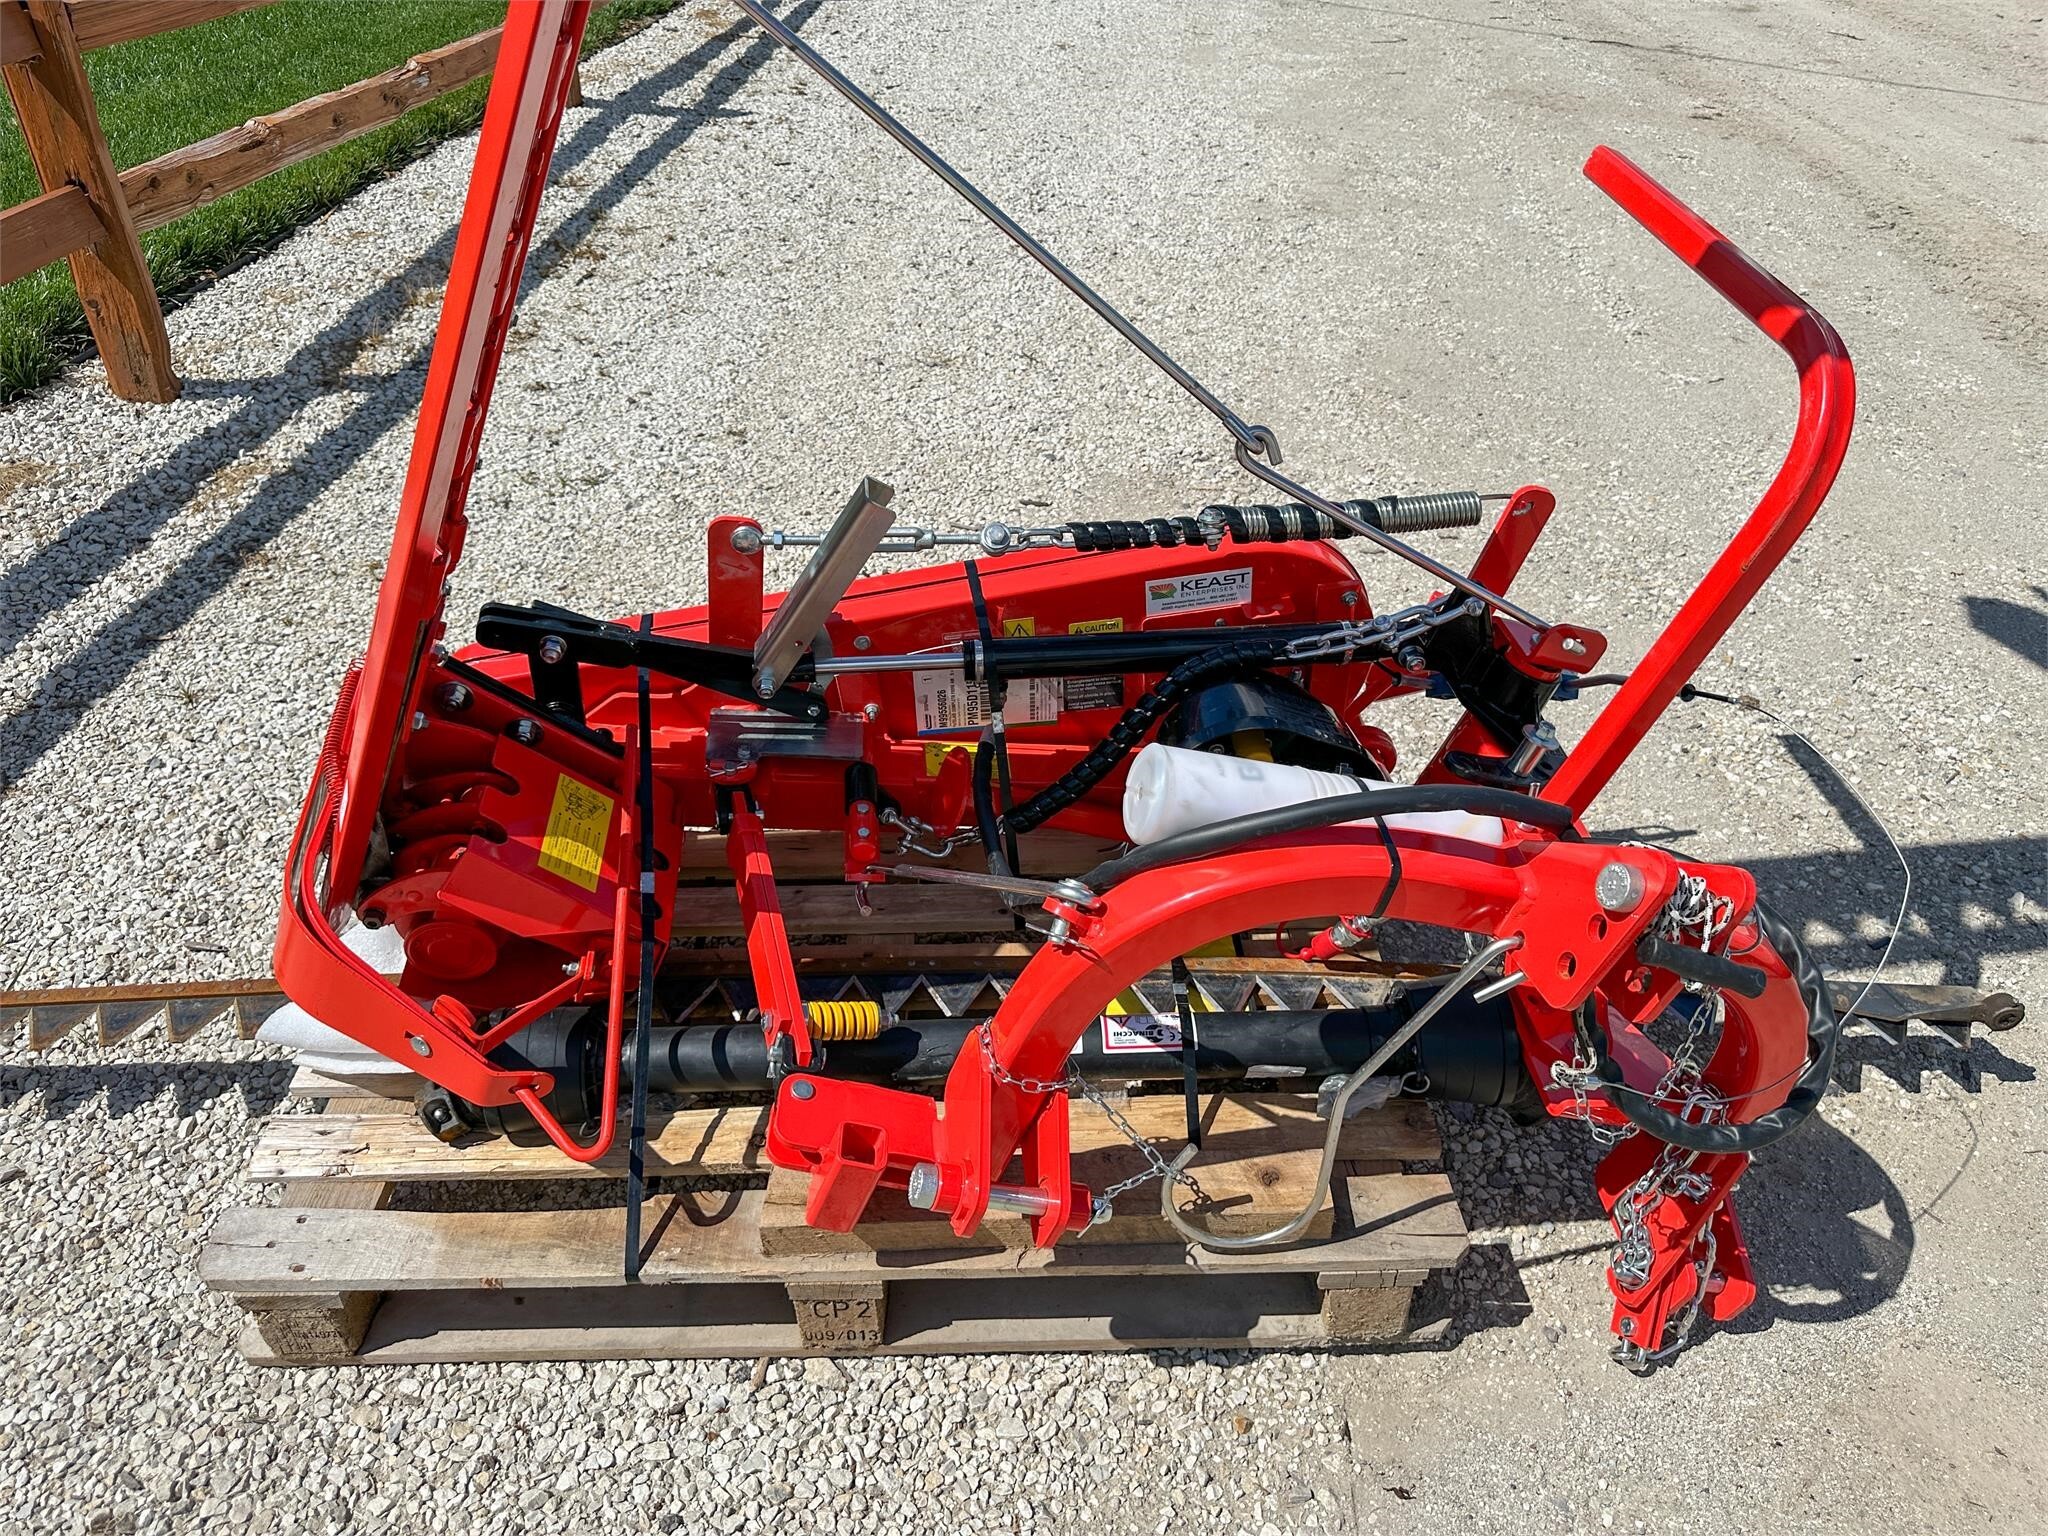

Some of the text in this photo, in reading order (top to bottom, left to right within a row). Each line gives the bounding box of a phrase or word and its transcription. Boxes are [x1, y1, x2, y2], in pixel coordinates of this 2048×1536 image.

[1181, 572, 1250, 591] KEAST
[1181, 585, 1233, 598] ENTERPRISES
[1084, 623, 1119, 633] CAUTION
[1113, 1029, 1155, 1037] BINACCHI
[813, 1300, 873, 1318] CP 2
